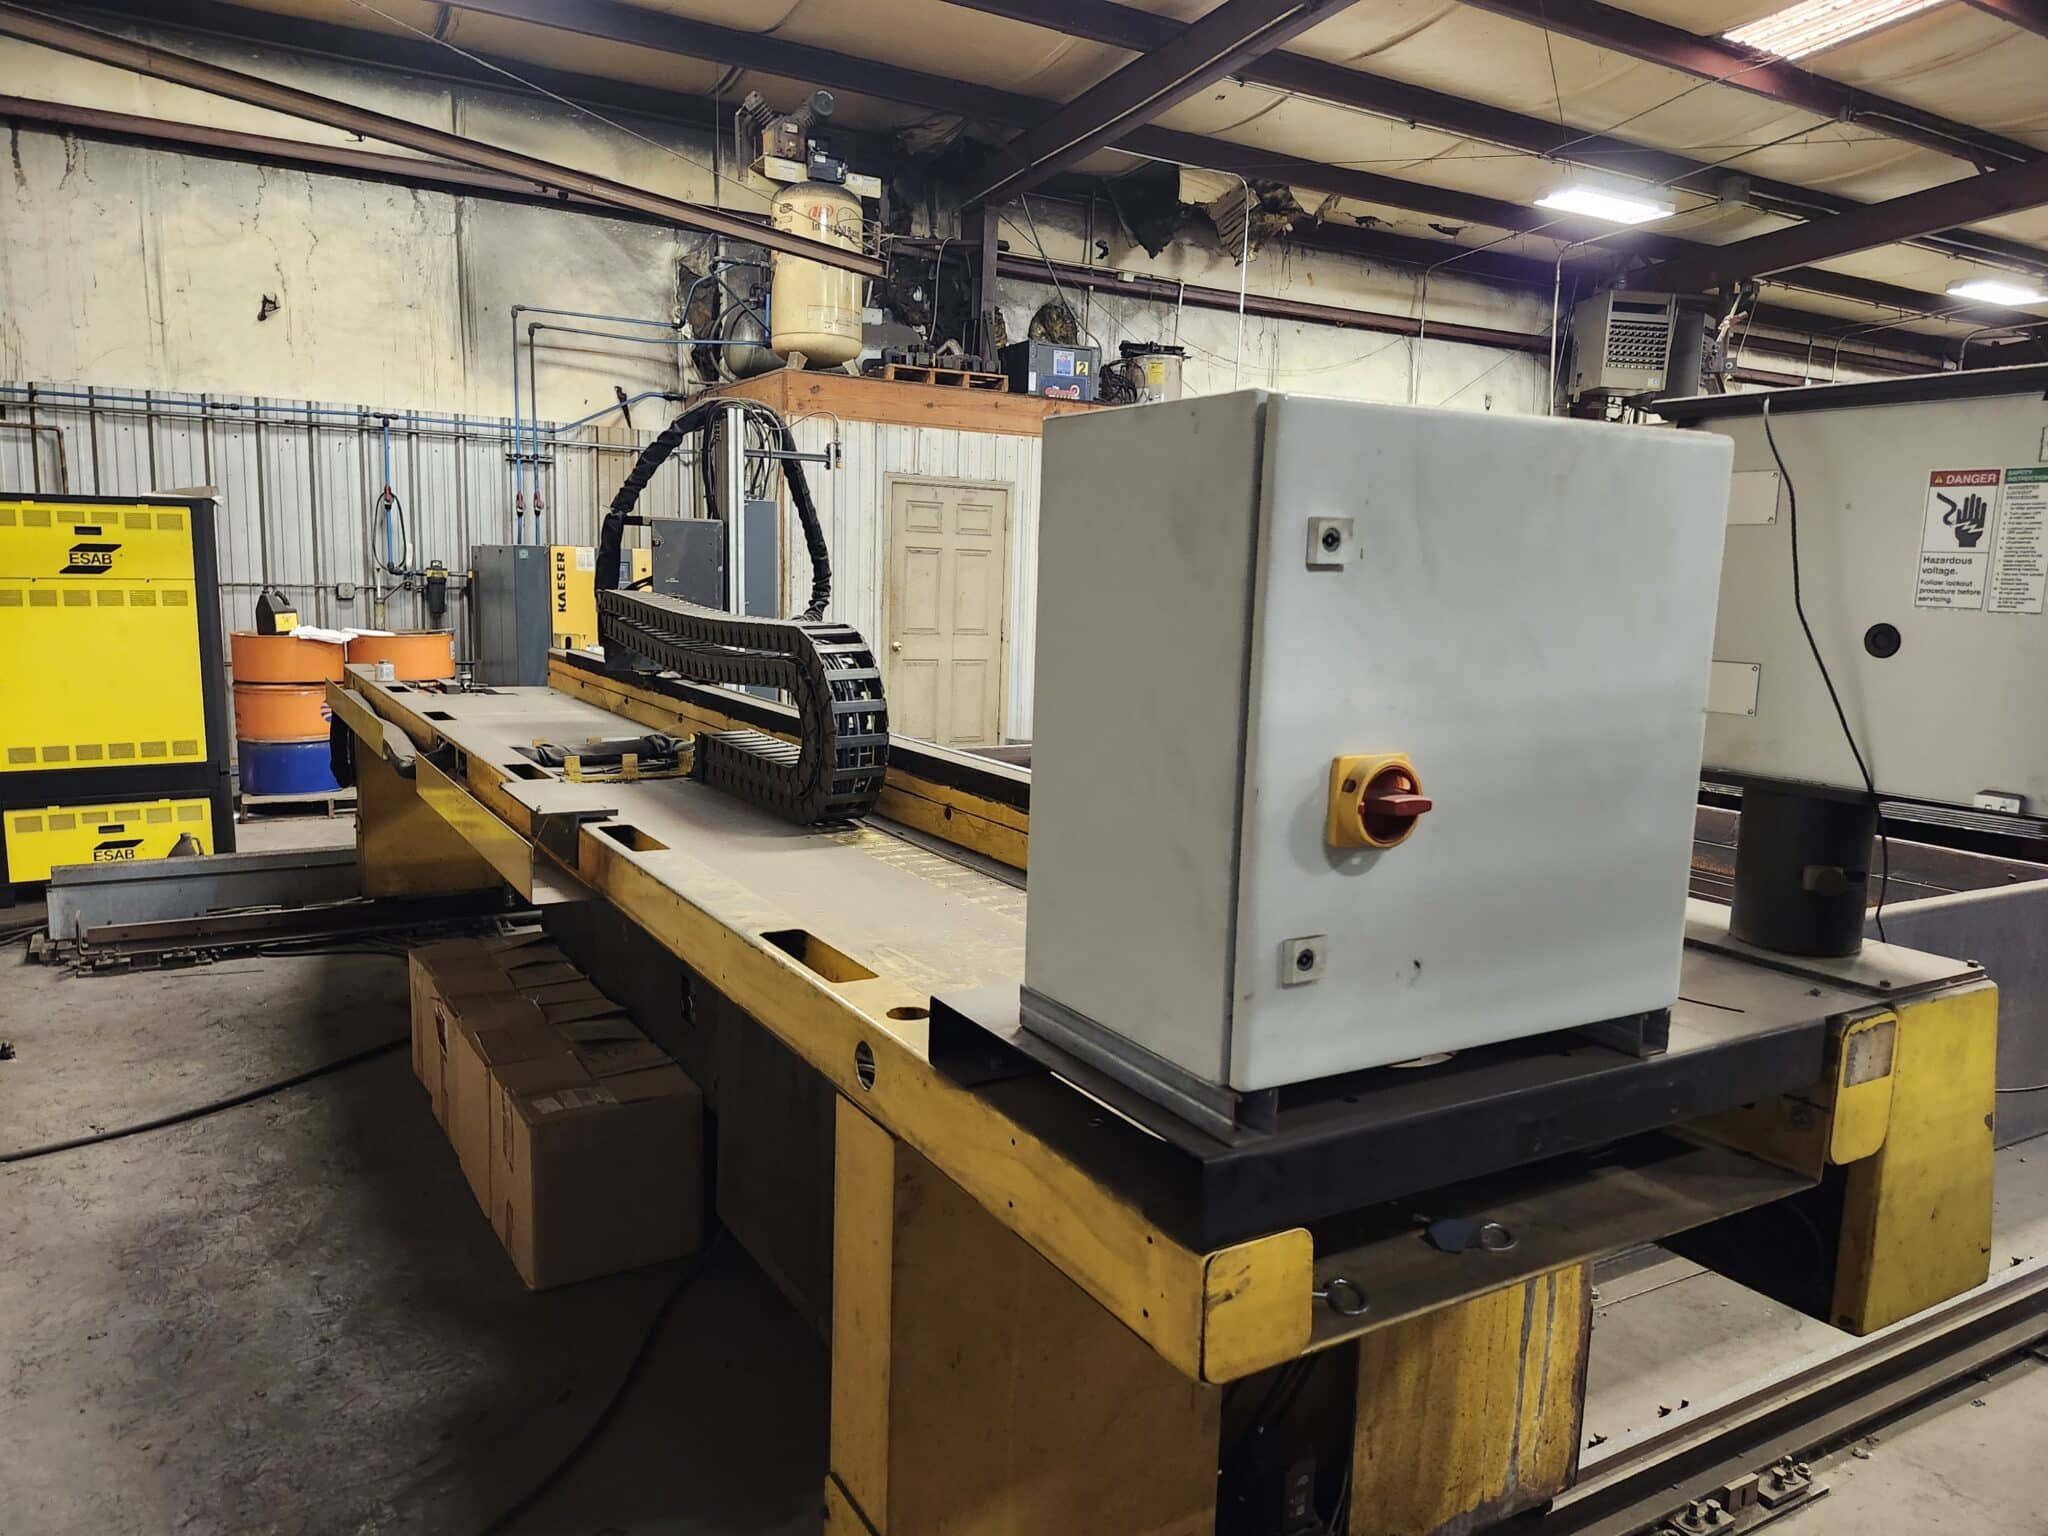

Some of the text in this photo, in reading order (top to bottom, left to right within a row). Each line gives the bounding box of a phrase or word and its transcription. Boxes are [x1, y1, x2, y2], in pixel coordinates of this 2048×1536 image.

[1079, 362, 1086, 375] 2
[1946, 473, 1997, 485] DANGER
[69, 552, 113, 566] ESAB
[1923, 556, 1973, 565] Hazardous
[1922, 567, 1958, 576] voltage.
[557, 552, 567, 612] KAESER
[93, 849, 135, 861] ESAB
